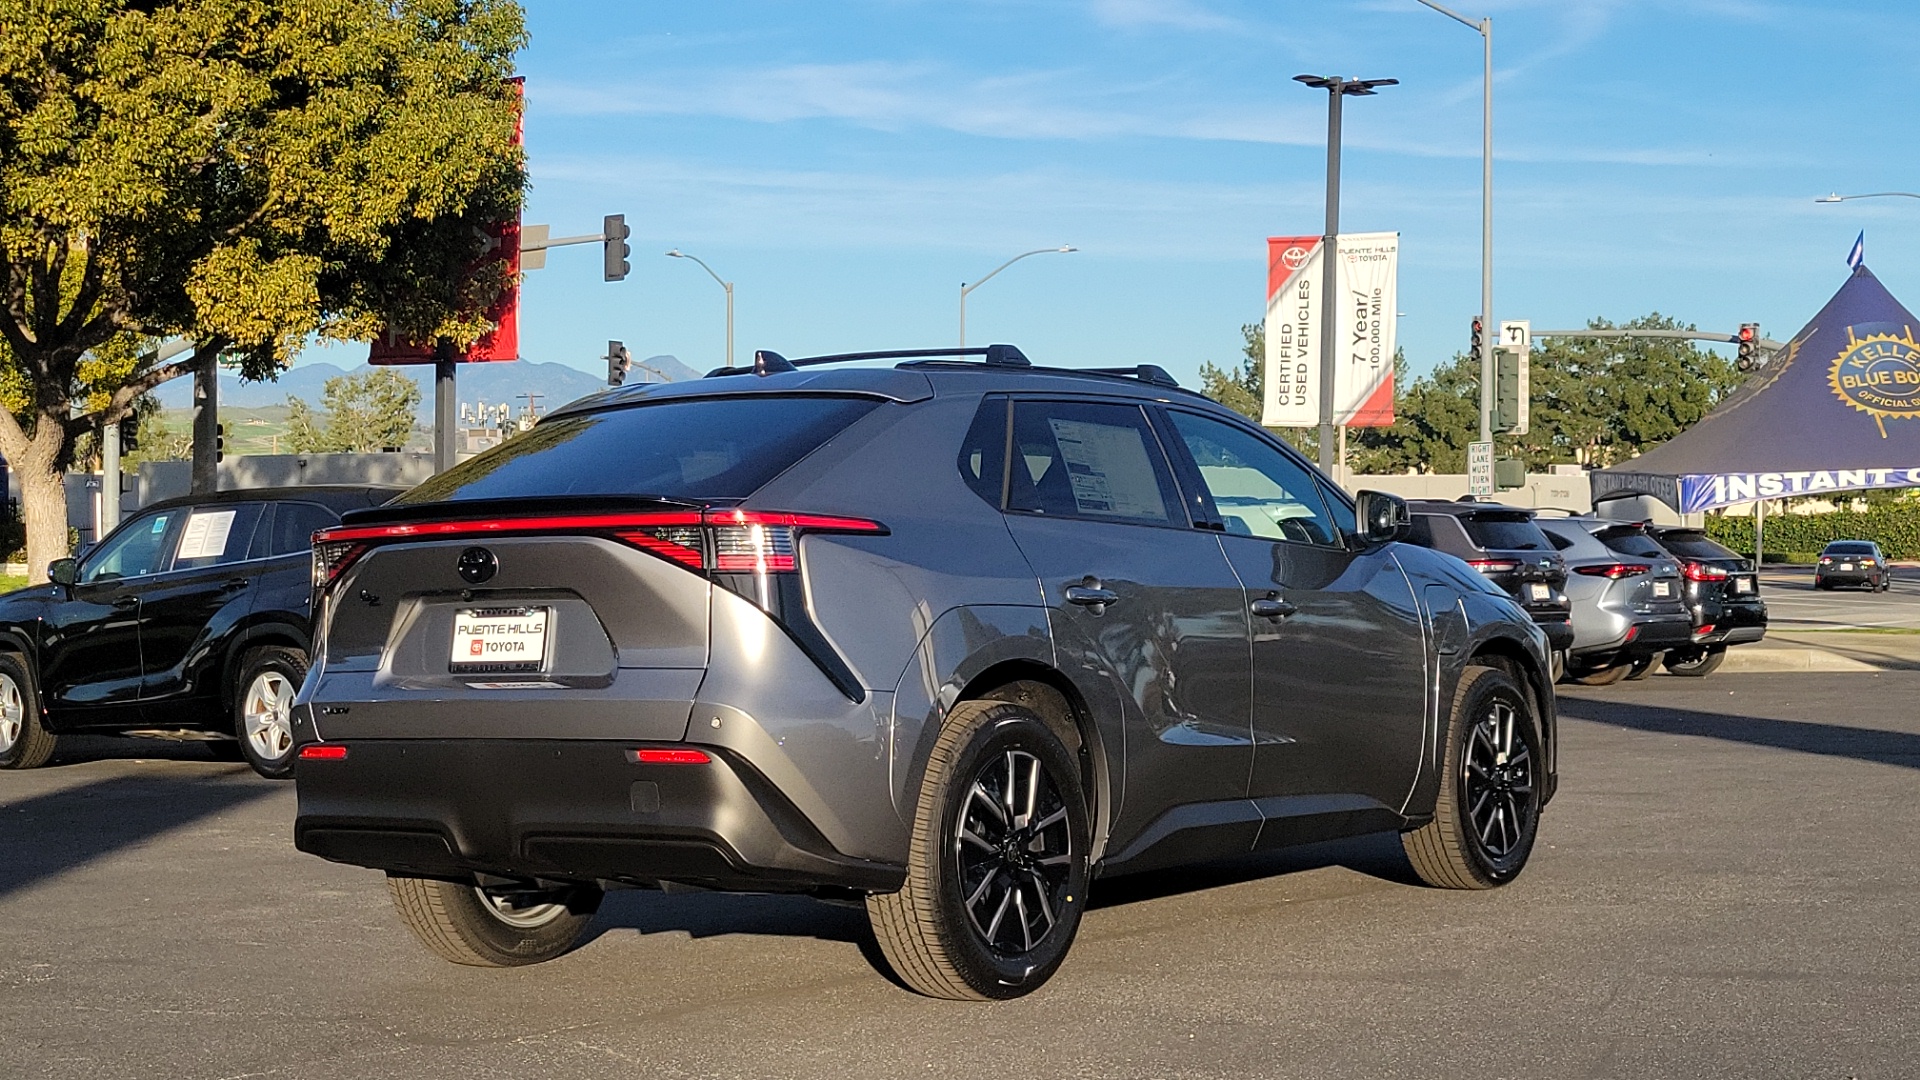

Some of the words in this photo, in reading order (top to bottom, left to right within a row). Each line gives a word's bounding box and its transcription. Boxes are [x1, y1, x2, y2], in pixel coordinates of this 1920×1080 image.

[1372, 287, 1382, 318] Mile
[1297, 279, 1310, 358] VEHICLES
[1352, 289, 1368, 346] Year/
[1370, 320, 1380, 370] 100,000
[1278, 323, 1292, 406] CERTIFIED
[1352, 353, 1366, 364] 7
[1848, 344, 1920, 368] KELLE
[1295, 363, 1307, 406] USED
[1842, 371, 1893, 388] BLUE
[1894, 370, 1920, 384] BO
[1858, 390, 1912, 407] OFFICIAL
[1471, 445, 1490, 453] RIGHT
[1472, 454, 1489, 463] LANE
[1472, 465, 1489, 473] MUST
[1472, 475, 1490, 484] TURN
[1714, 468, 1894, 504] INSTANT
[1471, 485, 1490, 494] RIGHT
[458, 624, 506, 635] PUENTE
[507, 623, 542, 634] HILLS
[485, 641, 525, 652] TOYOTA
